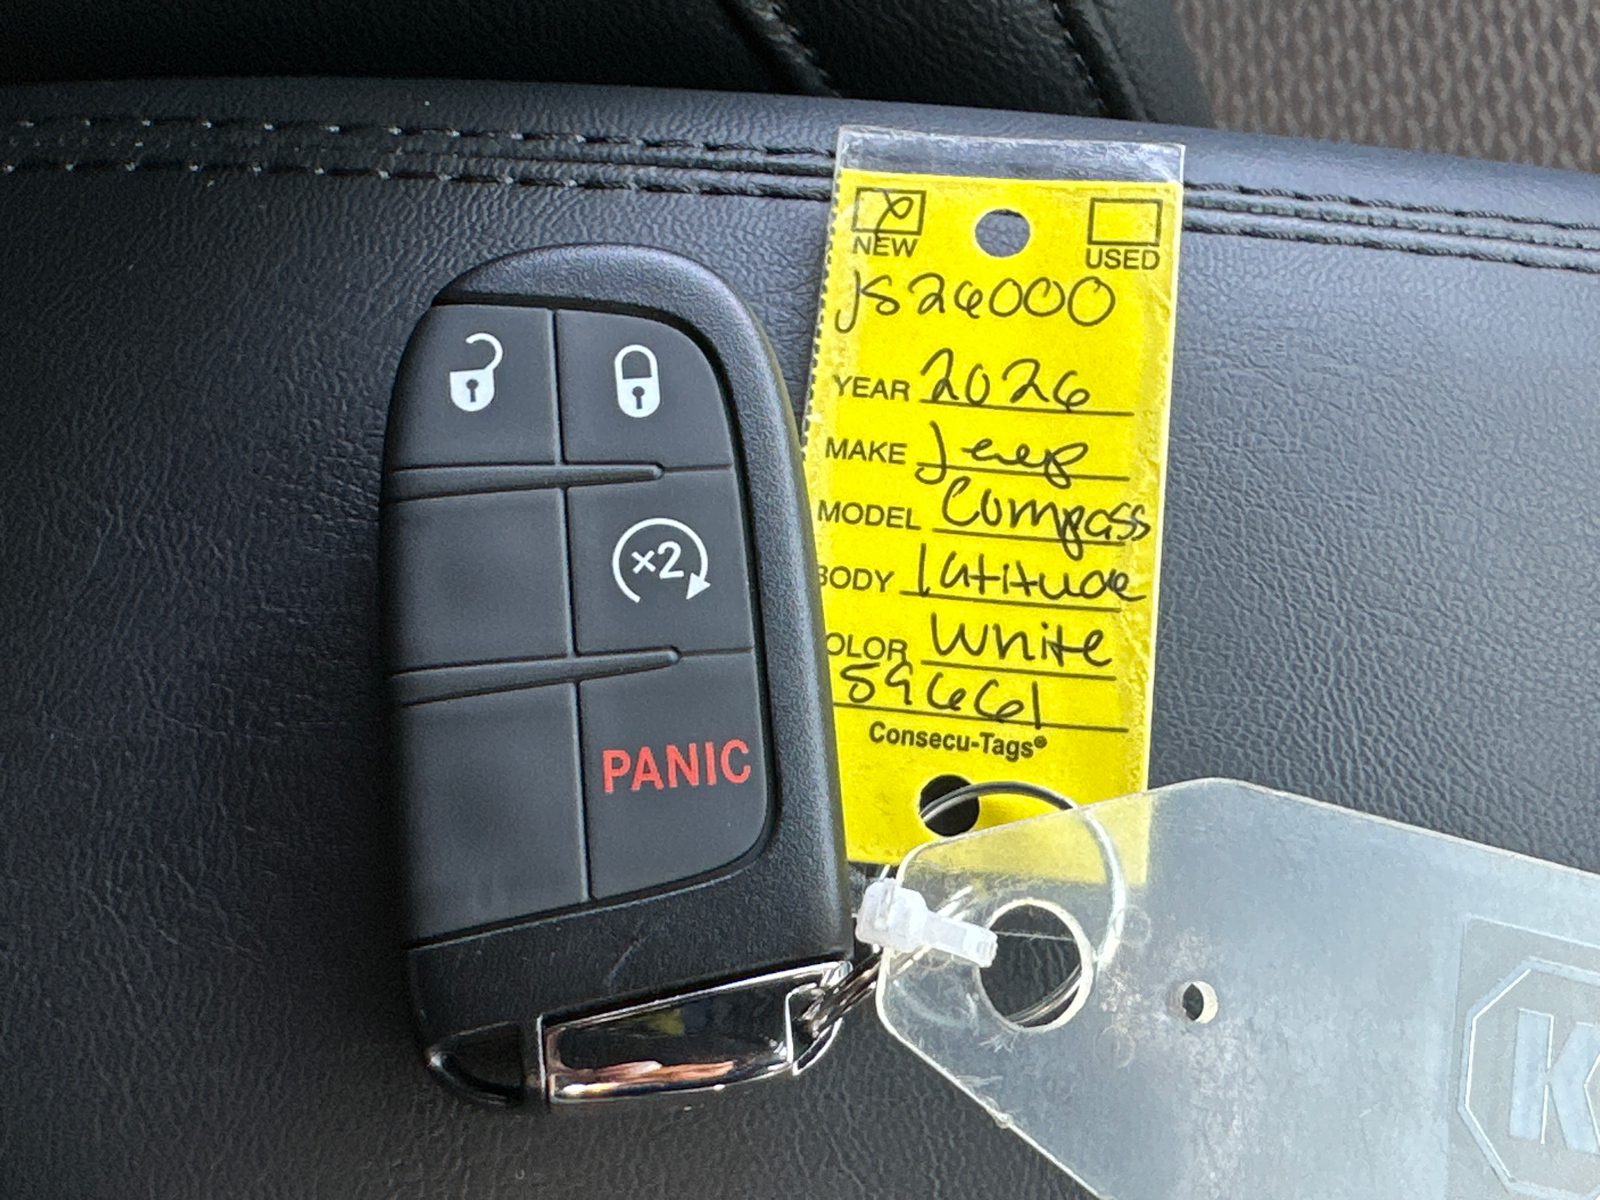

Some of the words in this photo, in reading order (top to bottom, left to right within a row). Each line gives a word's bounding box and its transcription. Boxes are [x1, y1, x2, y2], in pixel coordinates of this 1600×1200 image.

[852, 236, 919, 258] NEW
[1085, 248, 1161, 270] USED
[832, 374, 911, 401] YEAR
[921, 347, 1091, 413] 2026
[825, 437, 908, 466] MAKE
[914, 420, 1089, 489] Jeep
[816, 499, 922, 531] MODEL
[941, 475, 1151, 561] Compass
[930, 611, 1113, 667] White
[602, 738, 752, 794] PANIC
